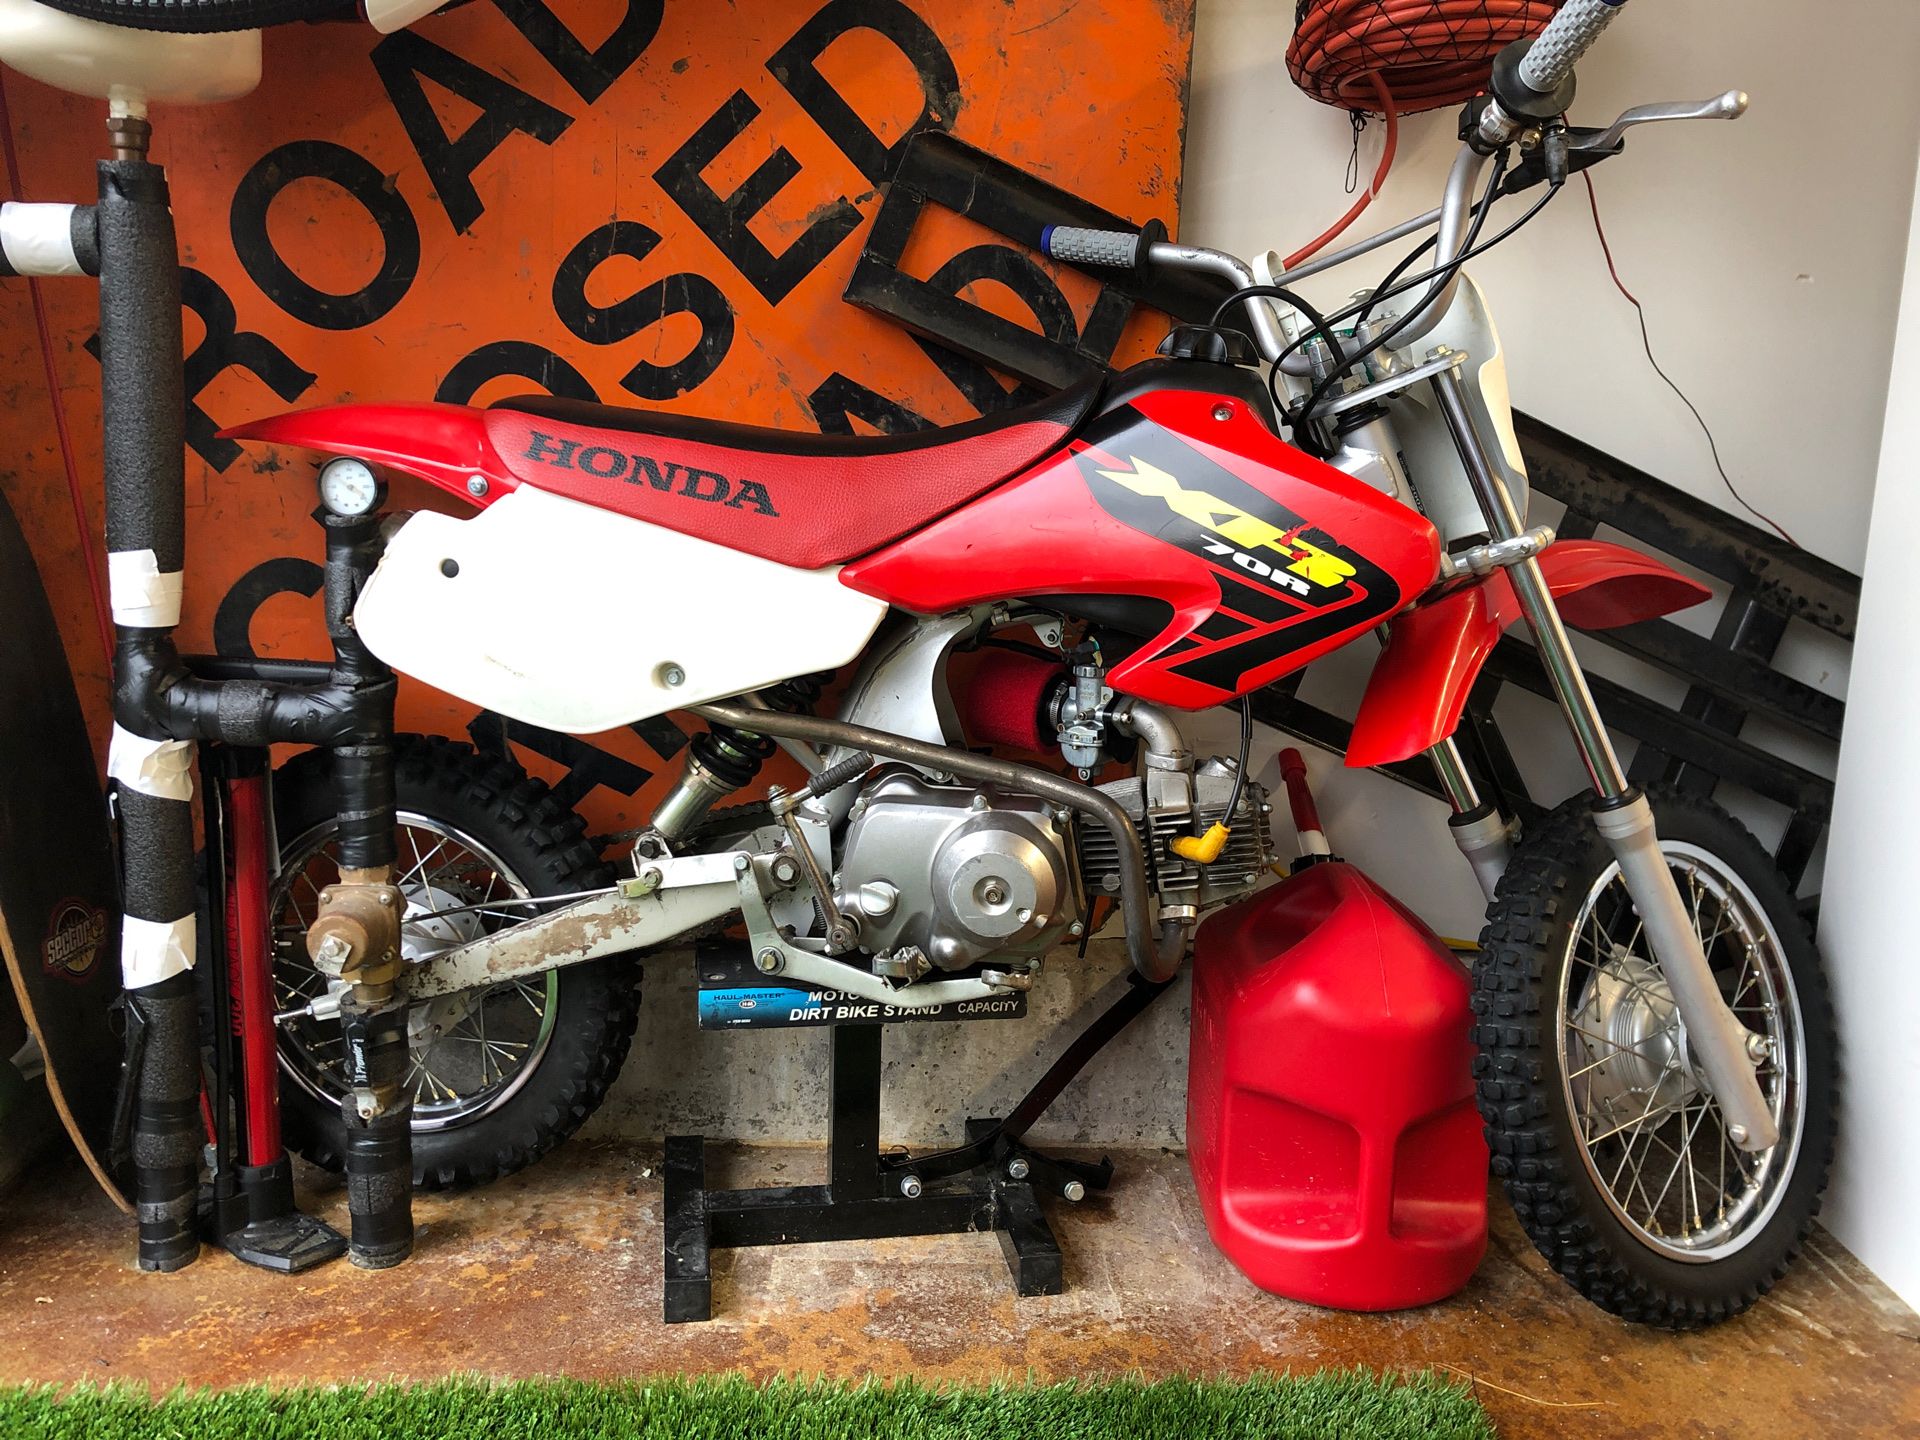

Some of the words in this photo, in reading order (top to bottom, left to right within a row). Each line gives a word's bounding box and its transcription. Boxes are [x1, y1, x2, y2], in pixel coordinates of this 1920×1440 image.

[523, 430, 780, 518] HONDA
[1200, 534, 1311, 596] 70R
[808, 990, 860, 1002] MOTO
[789, 1007, 833, 1021] DIRT
[836, 1004, 879, 1019] BIKE
[884, 1003, 943, 1017] STAND
[957, 1000, 1019, 1014] CAPACITY
